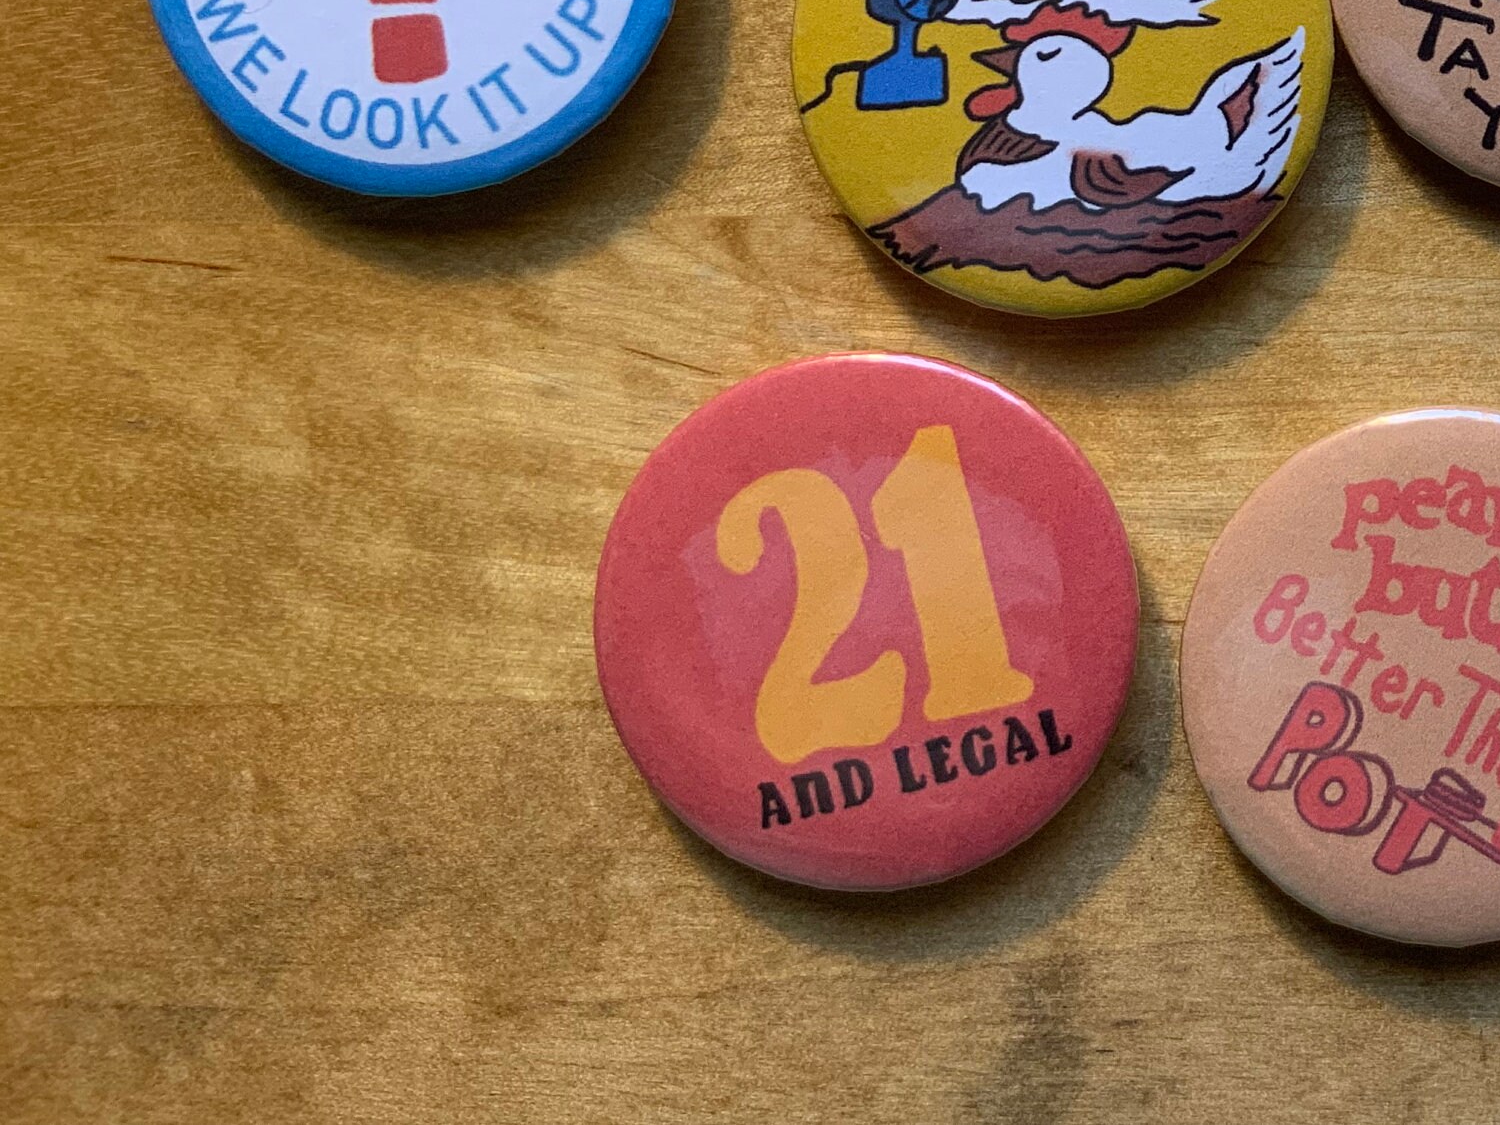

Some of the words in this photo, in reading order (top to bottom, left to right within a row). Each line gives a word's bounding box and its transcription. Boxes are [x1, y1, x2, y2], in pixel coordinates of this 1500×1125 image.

[278, 68, 461, 150] LOOK
[465, 62, 528, 134] IT
[714, 423, 1035, 764] 21
[1251, 573, 1447, 721] Better
[892, 708, 1074, 795] LEGAL
